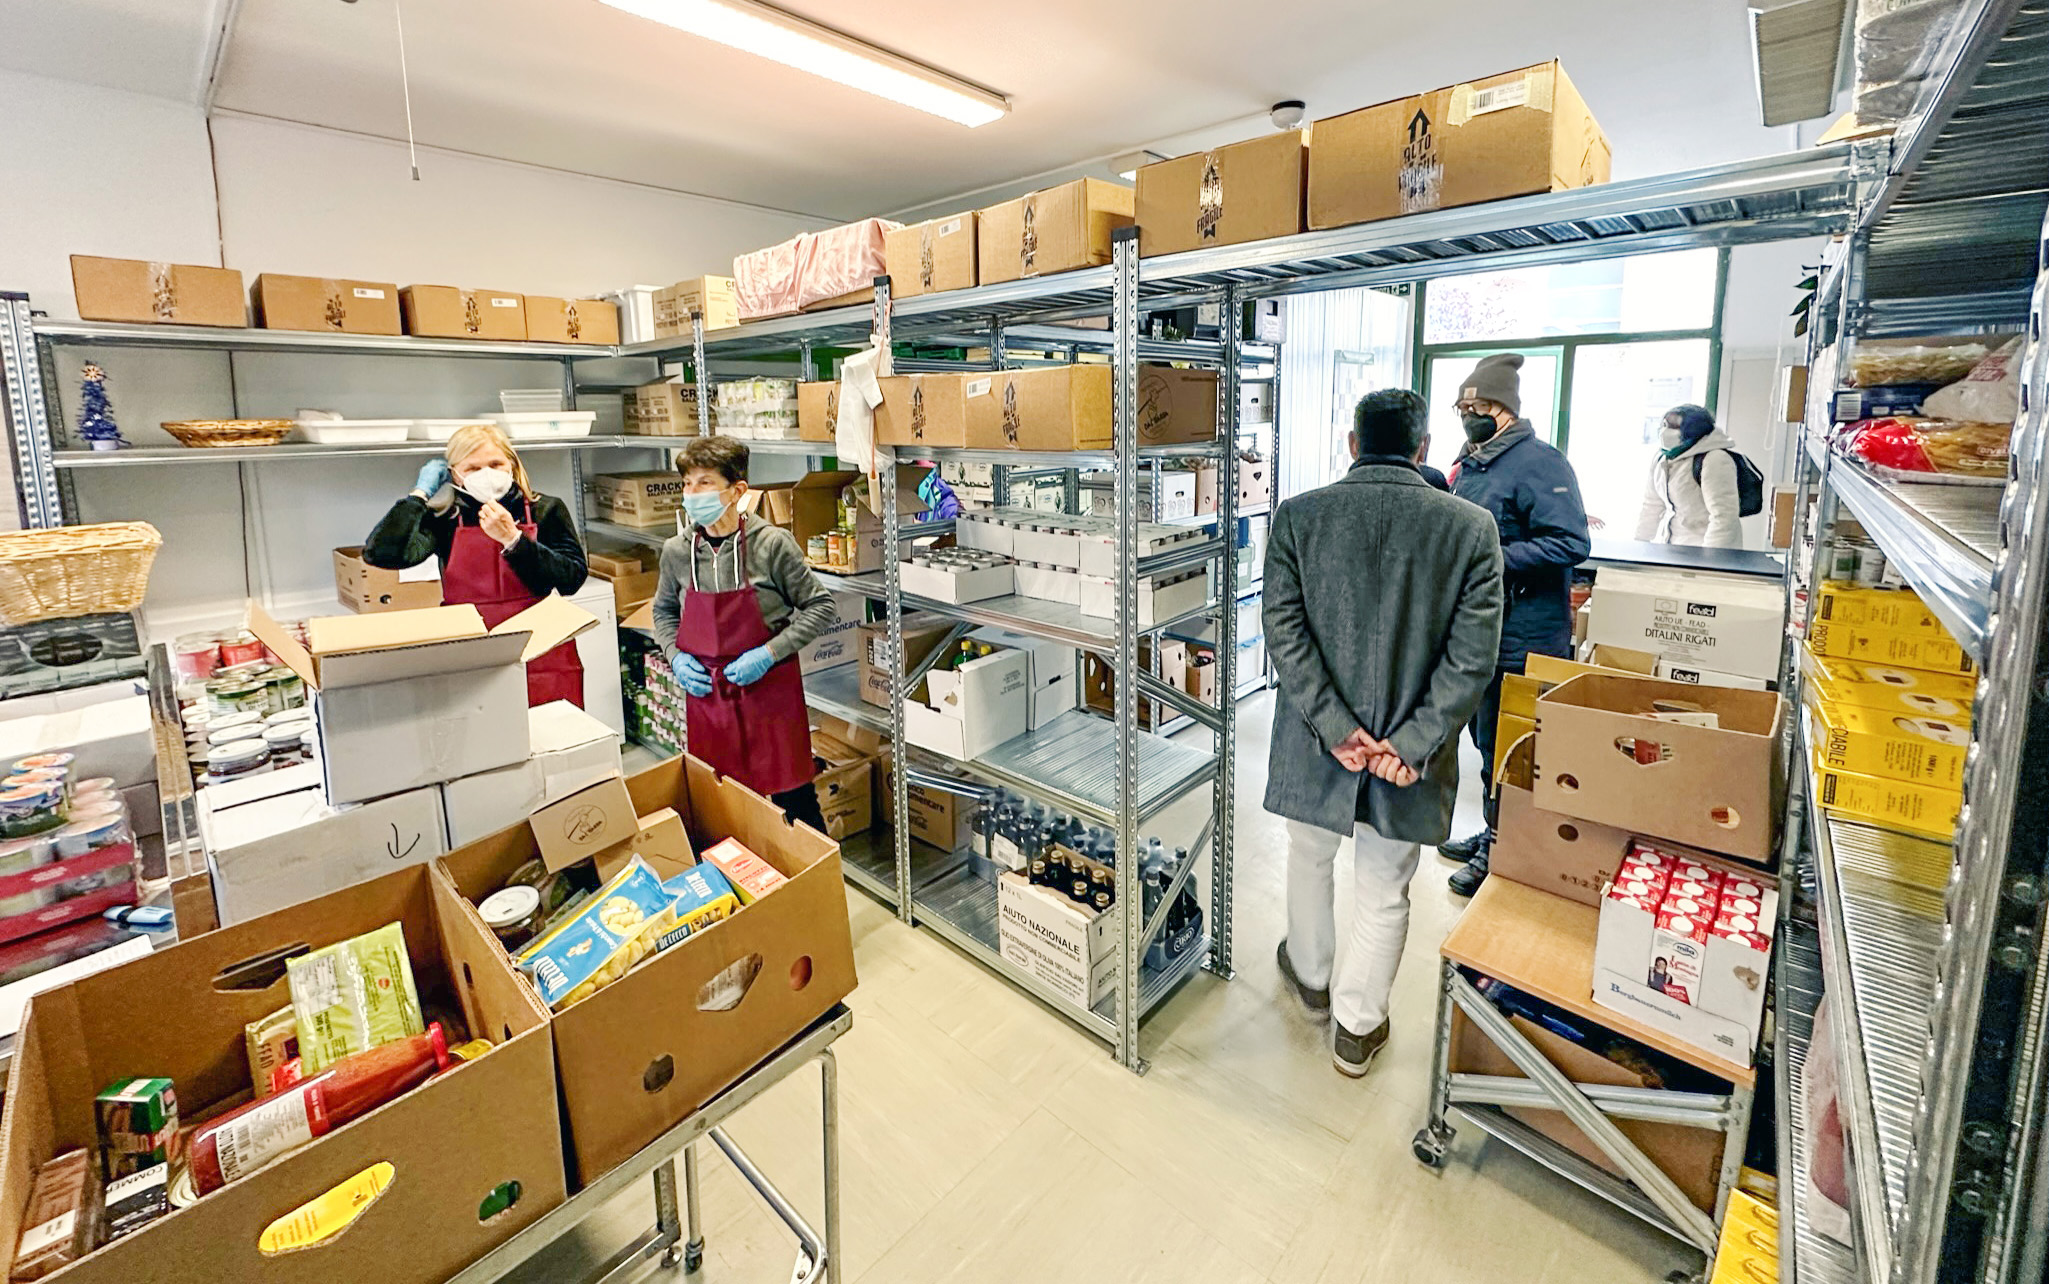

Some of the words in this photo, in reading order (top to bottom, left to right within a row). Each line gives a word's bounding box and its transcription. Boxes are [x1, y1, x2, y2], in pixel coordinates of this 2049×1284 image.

[1404, 133, 1431, 164] ALTO
[1645, 627, 1683, 642] DITALINI
[1685, 633, 1716, 647] RIGATI
[667, 926, 688, 946] CECCO
[1003, 904, 1028, 925] AIUTO
[1029, 918, 1081, 956] NAZIONALE
